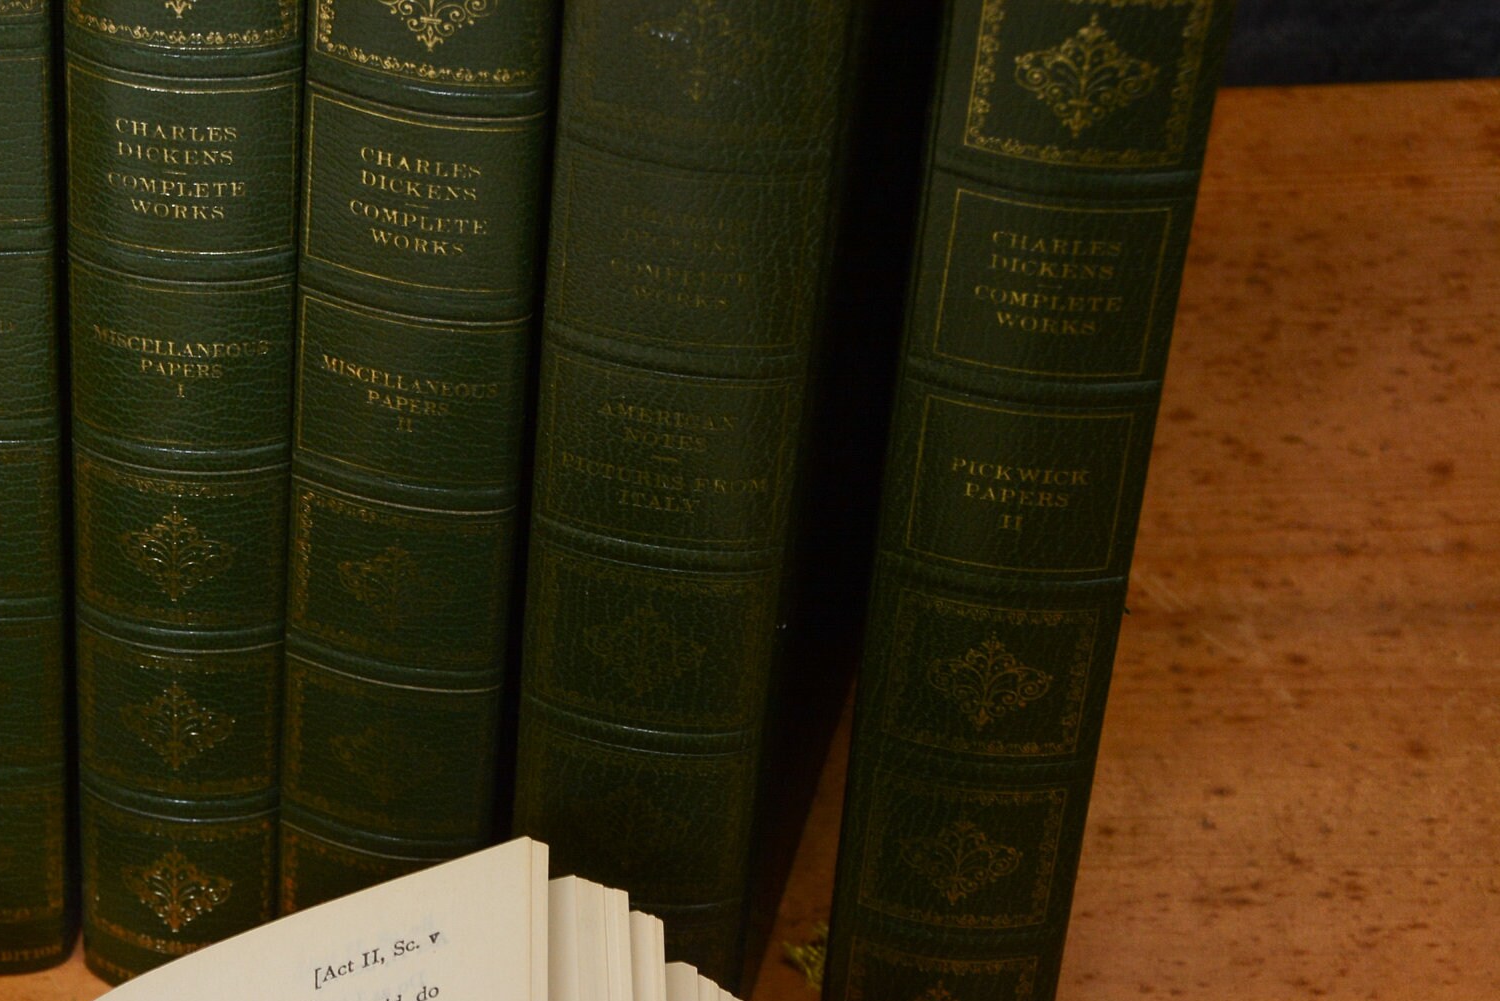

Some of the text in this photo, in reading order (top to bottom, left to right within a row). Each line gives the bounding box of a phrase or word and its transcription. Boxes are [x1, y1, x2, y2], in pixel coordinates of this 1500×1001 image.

[114, 117, 237, 142] CHARLES
[116, 142, 234, 166] DICKENS
[360, 146, 482, 179] CHARLES
[107, 170, 247, 199] COMPLETE
[360, 169, 478, 202] DICKENS
[129, 199, 226, 221] WORKS
[348, 200, 490, 236] COMPLETE
[370, 228, 466, 258] WORKS
[991, 230, 1125, 257] CHARLES
[990, 253, 1118, 282] DICKENS
[973, 285, 1123, 312] COMPLETE
[995, 310, 1097, 336] WORKS
[93, 324, 271, 358] MISCELLANEOUS
[140, 358, 224, 379] PAPERS
[320, 353, 498, 400] MISCELLANEOUS
[176, 384, 186, 398] I
[366, 390, 450, 417] PAPERS
[951, 456, 1091, 486] PICKWICK
[618, 490, 699, 513] ITALY
[962, 482, 1072, 508] PAPERS
[1000, 514, 1024, 530] II
[314, 931, 441, 990] [Act II, Sc. v
